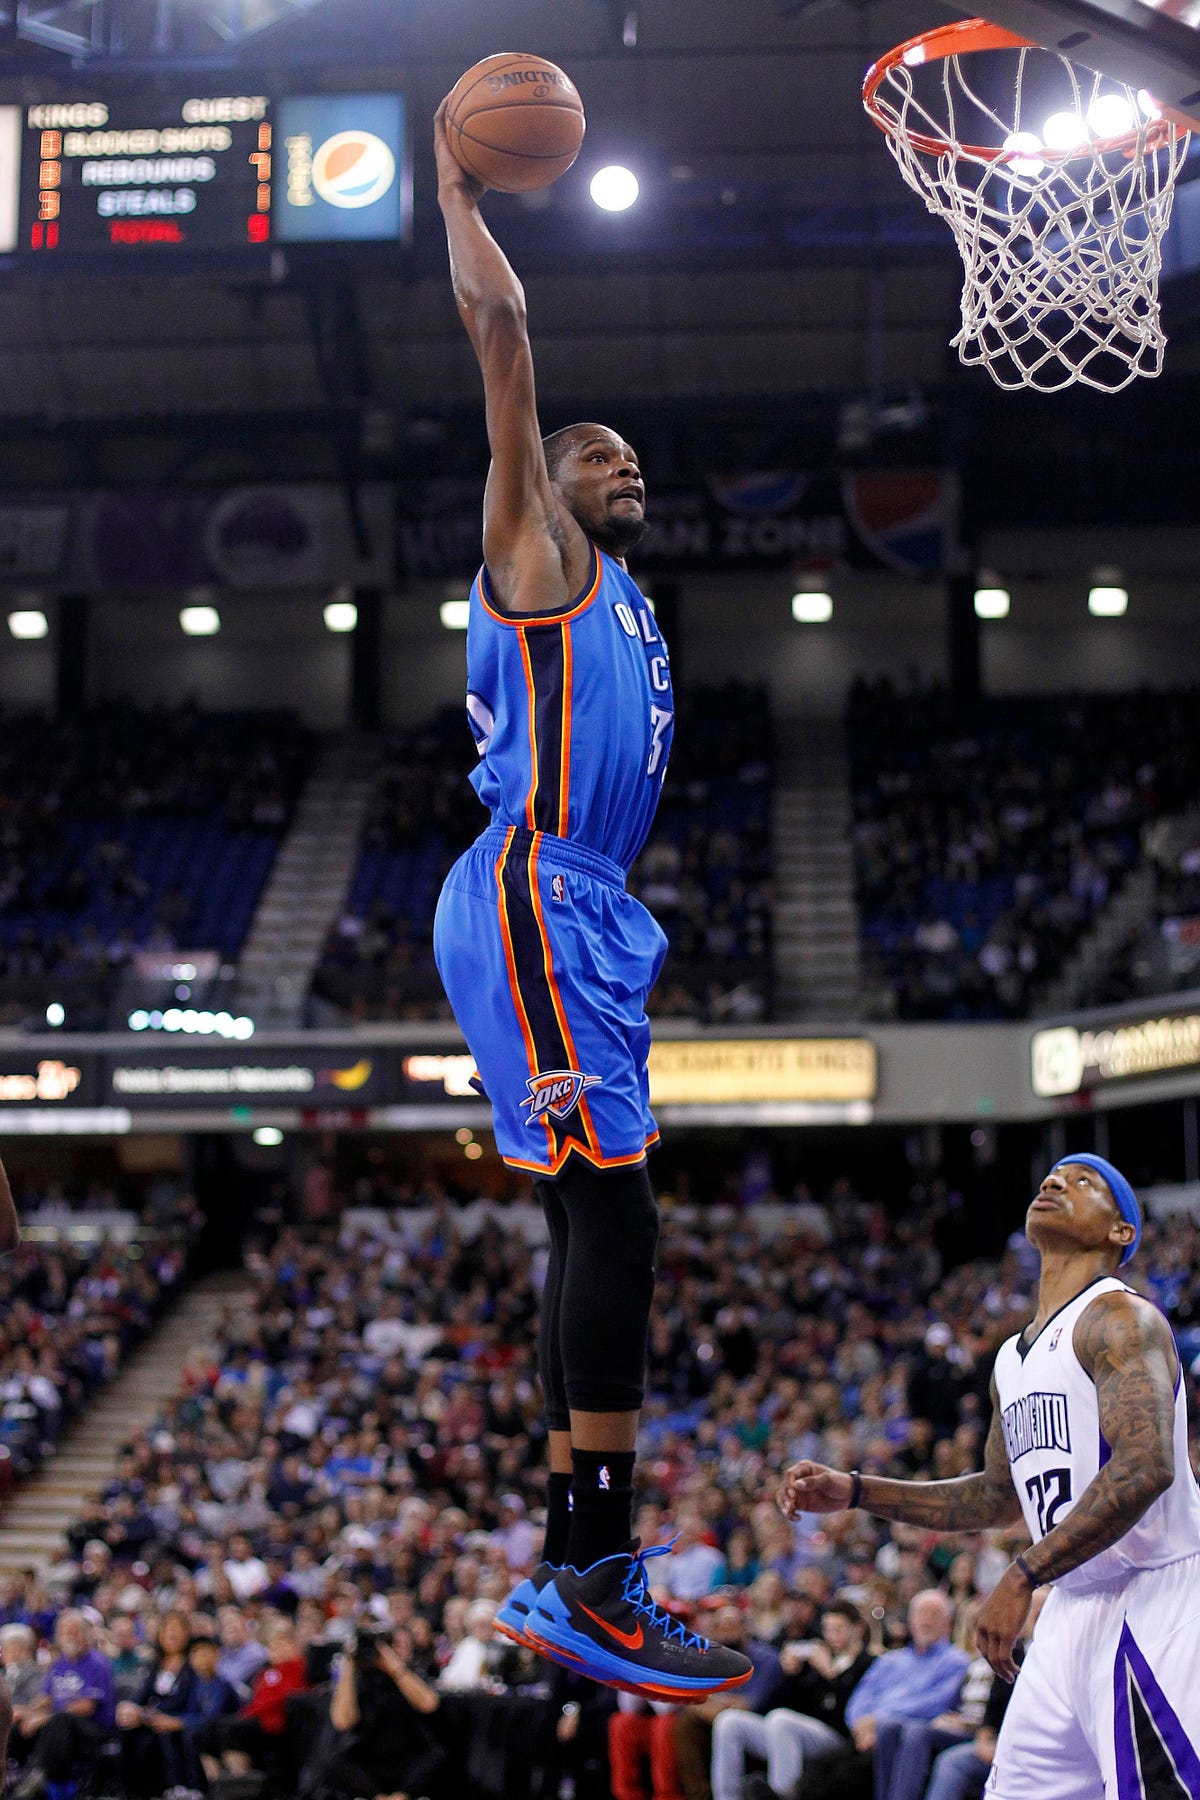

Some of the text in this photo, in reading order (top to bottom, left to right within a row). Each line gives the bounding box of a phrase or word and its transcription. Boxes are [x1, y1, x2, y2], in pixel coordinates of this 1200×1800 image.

[28, 102, 109, 129] KINGS
[182, 96, 270, 124] GUEST
[82, 156, 216, 186] REBOUNDS
[97, 188, 197, 217] STEALS
[532, 1078, 572, 1112] OKC
